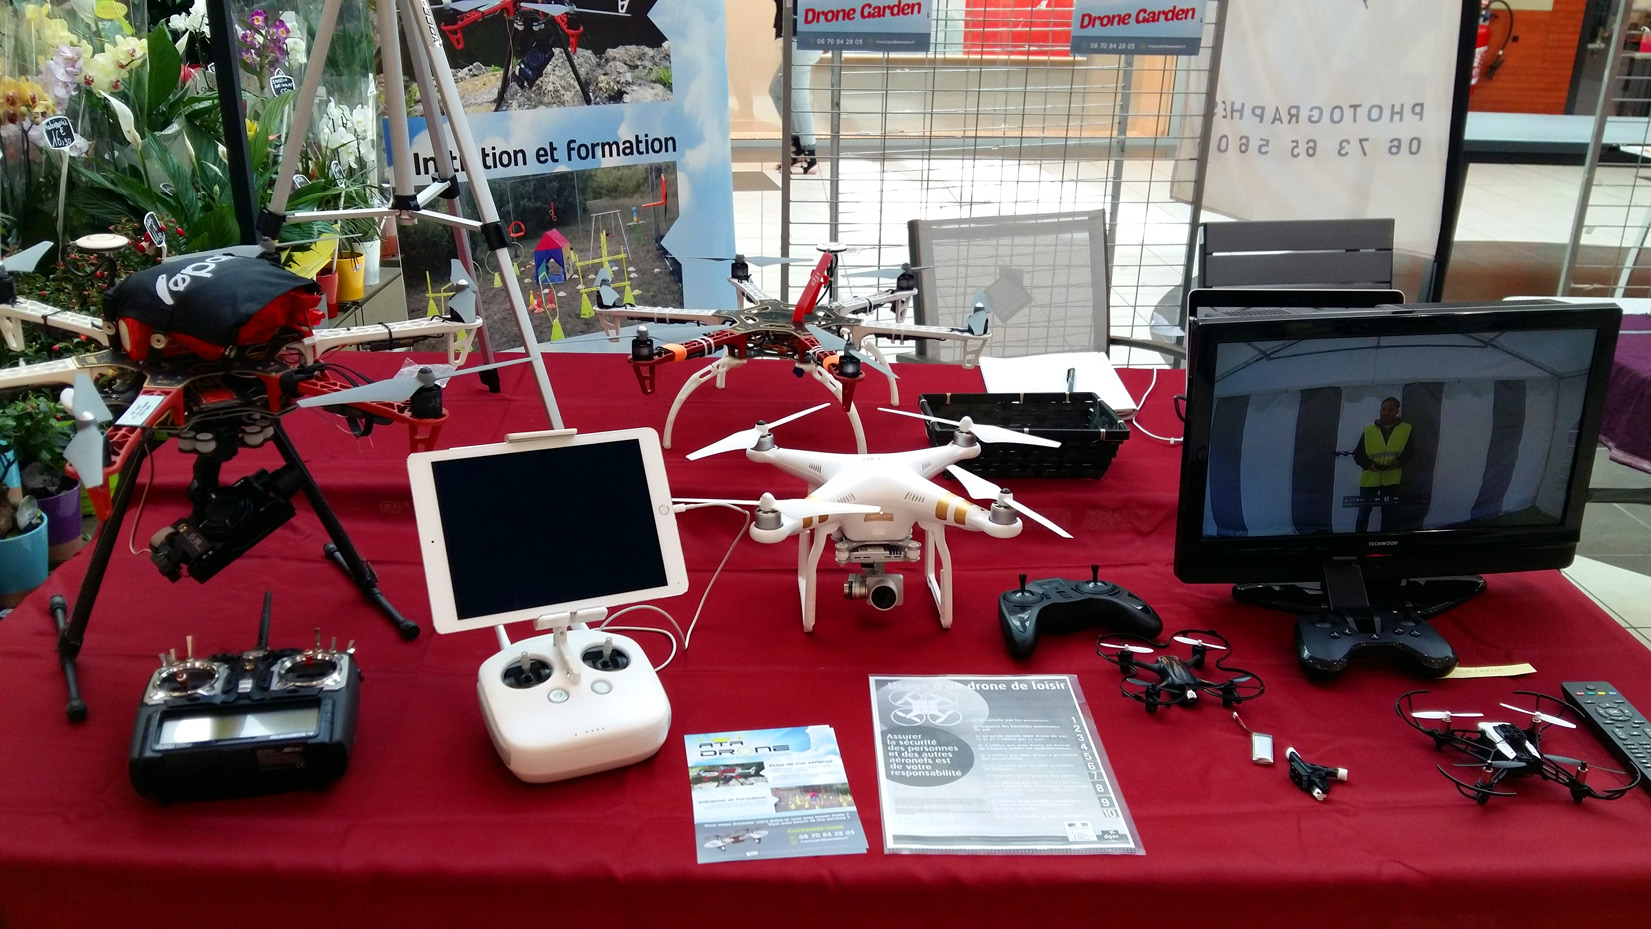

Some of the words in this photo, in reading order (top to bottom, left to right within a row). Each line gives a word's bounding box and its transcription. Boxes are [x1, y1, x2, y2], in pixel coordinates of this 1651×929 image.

[804, 8, 856, 25] Drone
[860, 0, 922, 19] Garden
[1080, 13, 1132, 29] Drone
[1135, 5, 1196, 24] Garden
[1127, 42, 1136, 50] 05
[535, 141, 559, 164] et
[566, 133, 677, 162] formation
[967, 681, 1007, 690] drone
[1011, 681, 1028, 690] de
[1031, 681, 1066, 690] loisir
[1071, 716, 1077, 724] 1
[1073, 724, 1081, 733] 2
[1076, 733, 1085, 742] 3
[1083, 752, 1092, 761] 5
[1087, 762, 1096, 770] 6
[890, 769, 962, 778] responsabilité
[1091, 771, 1097, 780] 7
[1095, 783, 1104, 792] 8
[1101, 798, 1110, 807] 9
[1103, 808, 1116, 818] 10
